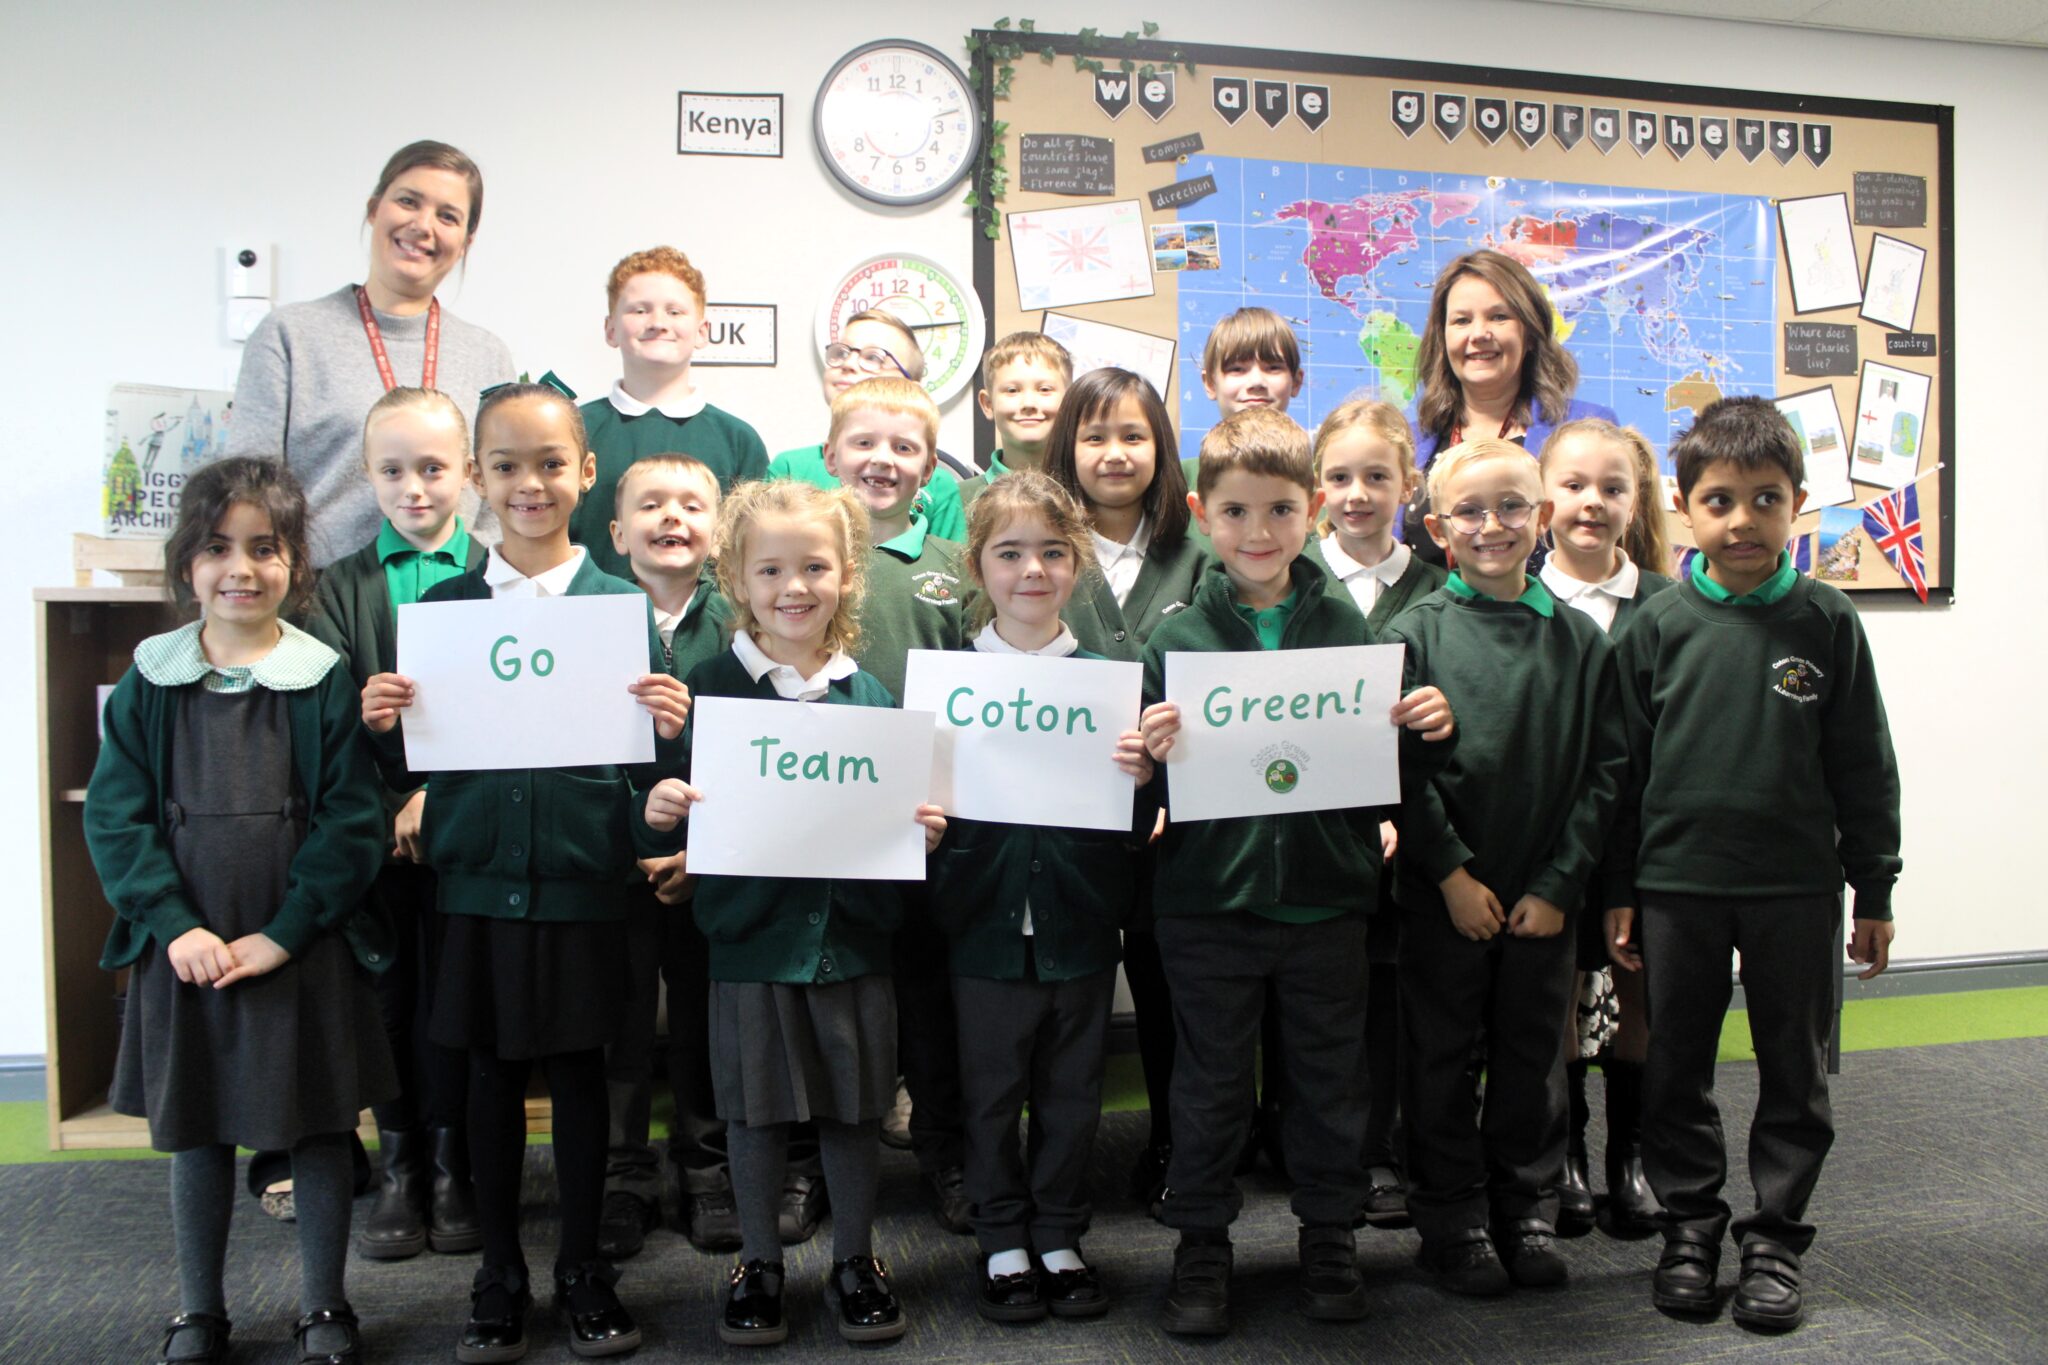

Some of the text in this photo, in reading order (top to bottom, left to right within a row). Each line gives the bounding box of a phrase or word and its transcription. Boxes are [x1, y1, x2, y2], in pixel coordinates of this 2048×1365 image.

[889, 74, 906, 89] 12
[1098, 78, 1822, 154] we are geographers!
[688, 110, 772, 141] Kenya
[934, 120, 944, 135] 3
[854, 137, 864, 152] 8
[929, 141, 940, 155] 4
[1023, 137, 1038, 149] Do
[1043, 137, 1061, 149] all
[870, 156, 880, 171] 7
[892, 160, 903, 175] 6
[915, 157, 926, 172] 5
[1046, 167, 1070, 175] same
[1205, 160, 1215, 173] A
[1272, 166, 1281, 177] B
[1336, 170, 1345, 182] C
[1398, 174, 1408, 186] D
[1156, 180, 1211, 207] direction
[871, 282, 884, 297] 11
[892, 279, 909, 294] 12
[851, 299, 869, 314] 10
[935, 301, 945, 316] 2
[706, 322, 746, 345] UK
[1789, 326, 1846, 339] Where does
[1815, 342, 1850, 354] Charles
[1888, 336, 1929, 352] country
[932, 345, 942, 360] 4
[144, 472, 188, 487] IGG
[110, 511, 178, 529] ARCHI
[489, 634, 555, 682] Go
[1203, 678, 1366, 728] Green!
[946, 686, 1098, 736] Coton
[750, 735, 880, 784] Team
